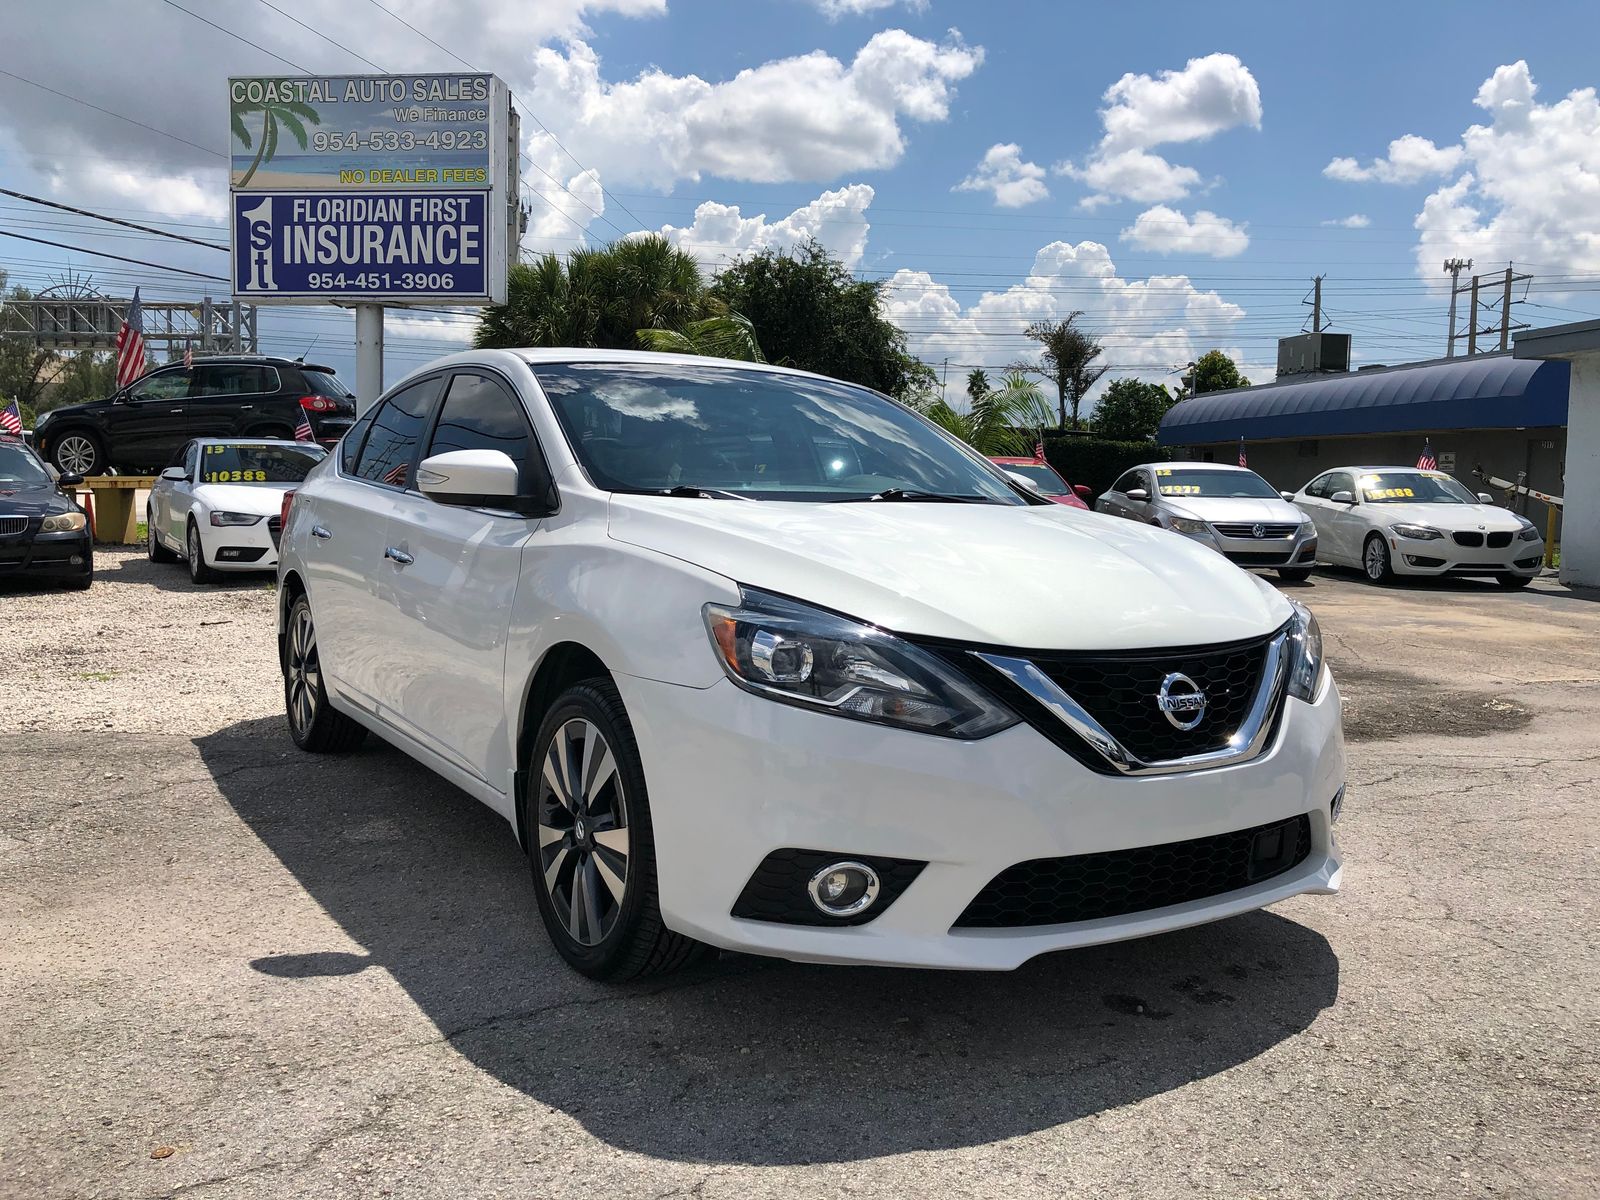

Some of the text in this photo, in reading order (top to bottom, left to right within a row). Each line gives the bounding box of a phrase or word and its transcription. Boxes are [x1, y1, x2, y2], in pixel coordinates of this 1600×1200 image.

[231, 78, 488, 103] COASTAL AUTO SALES
[394, 107, 487, 122] We Finance
[312, 130, 488, 151] 954-533-4923
[340, 168, 487, 184] NO DEALER FEES
[293, 198, 471, 223] FLORIDIAN FIRST
[283, 224, 480, 266] INSURANCE
[308, 272, 455, 289] 954-451-3906
[206, 445, 225, 454] 13
[1167, 696, 1205, 709] NISSAN
